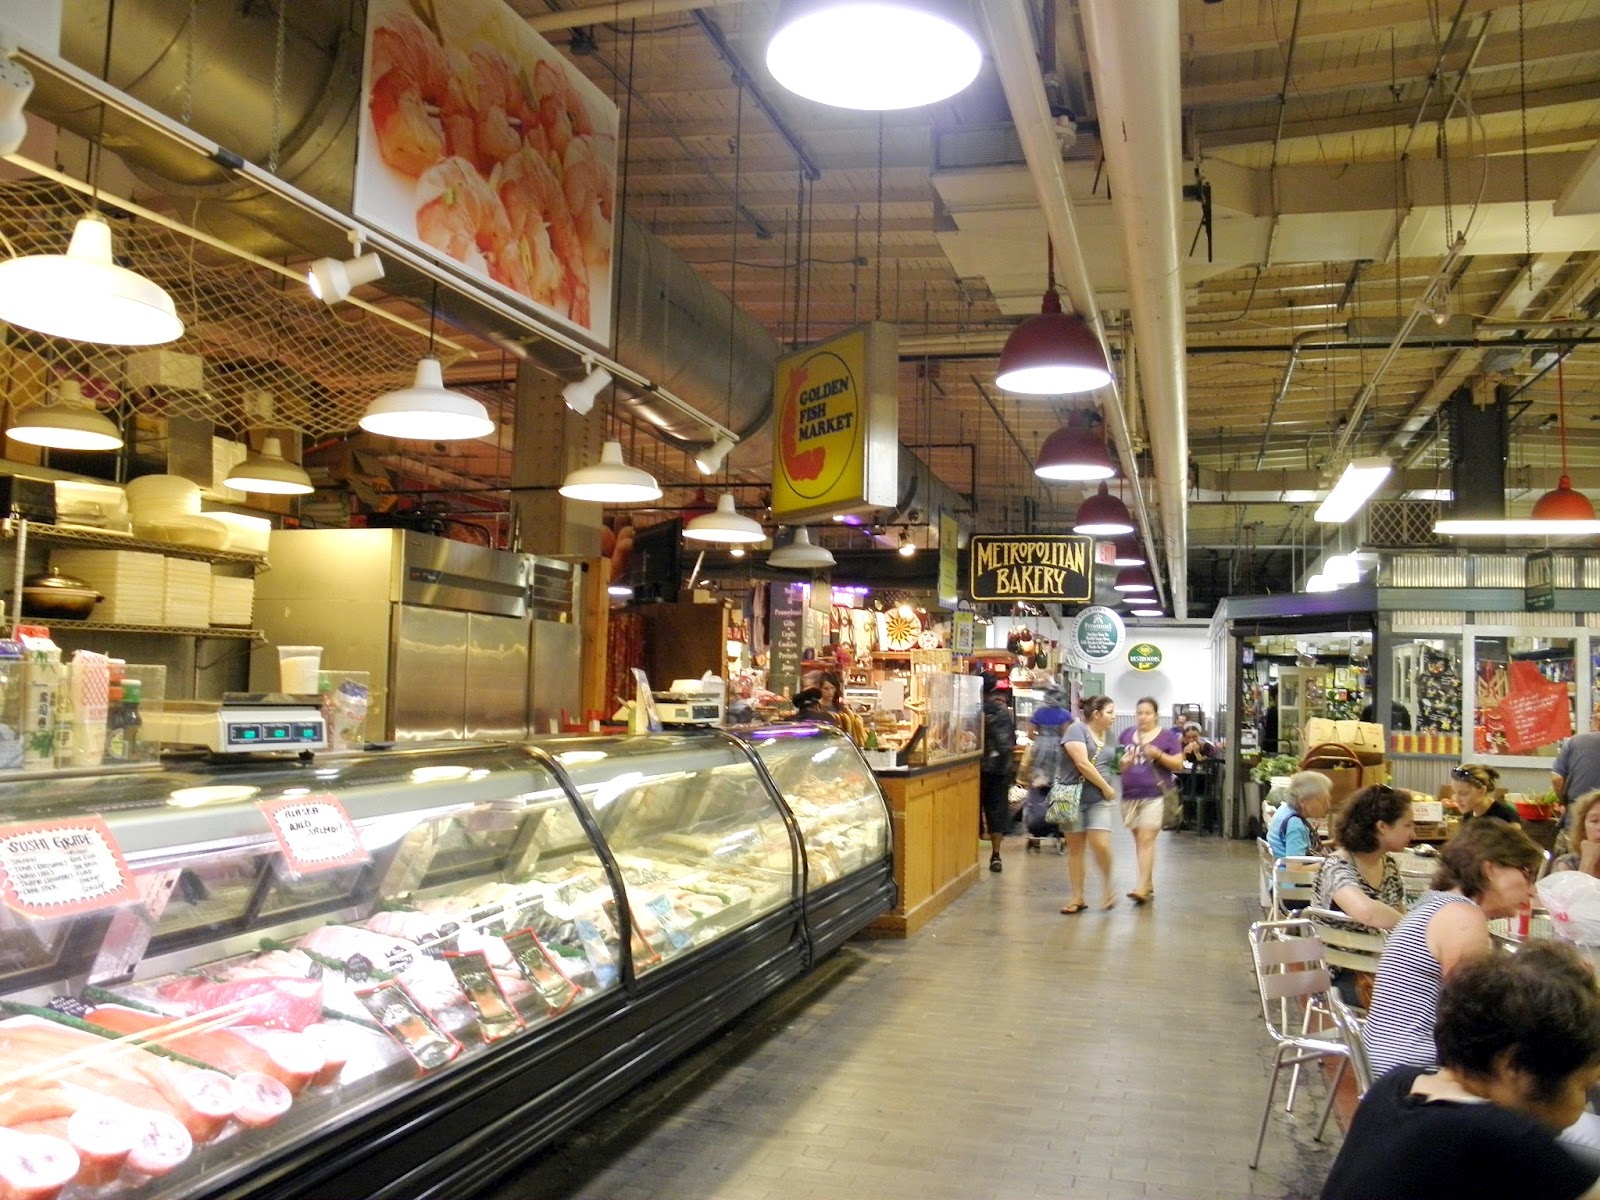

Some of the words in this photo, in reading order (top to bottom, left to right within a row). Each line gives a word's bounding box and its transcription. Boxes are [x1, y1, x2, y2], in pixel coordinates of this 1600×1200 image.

[800, 377, 849, 406] GOLDEN
[799, 412, 853, 442] MARKET
[800, 403, 826, 424] FISH
[977, 542, 1085, 577] METROPOLITAN
[996, 565, 1067, 594] BAKERY
[1129, 655, 1160, 663] RESTROOMS
[7, 838, 51, 853] SUSHI
[52, 833, 94, 850] GRADE
